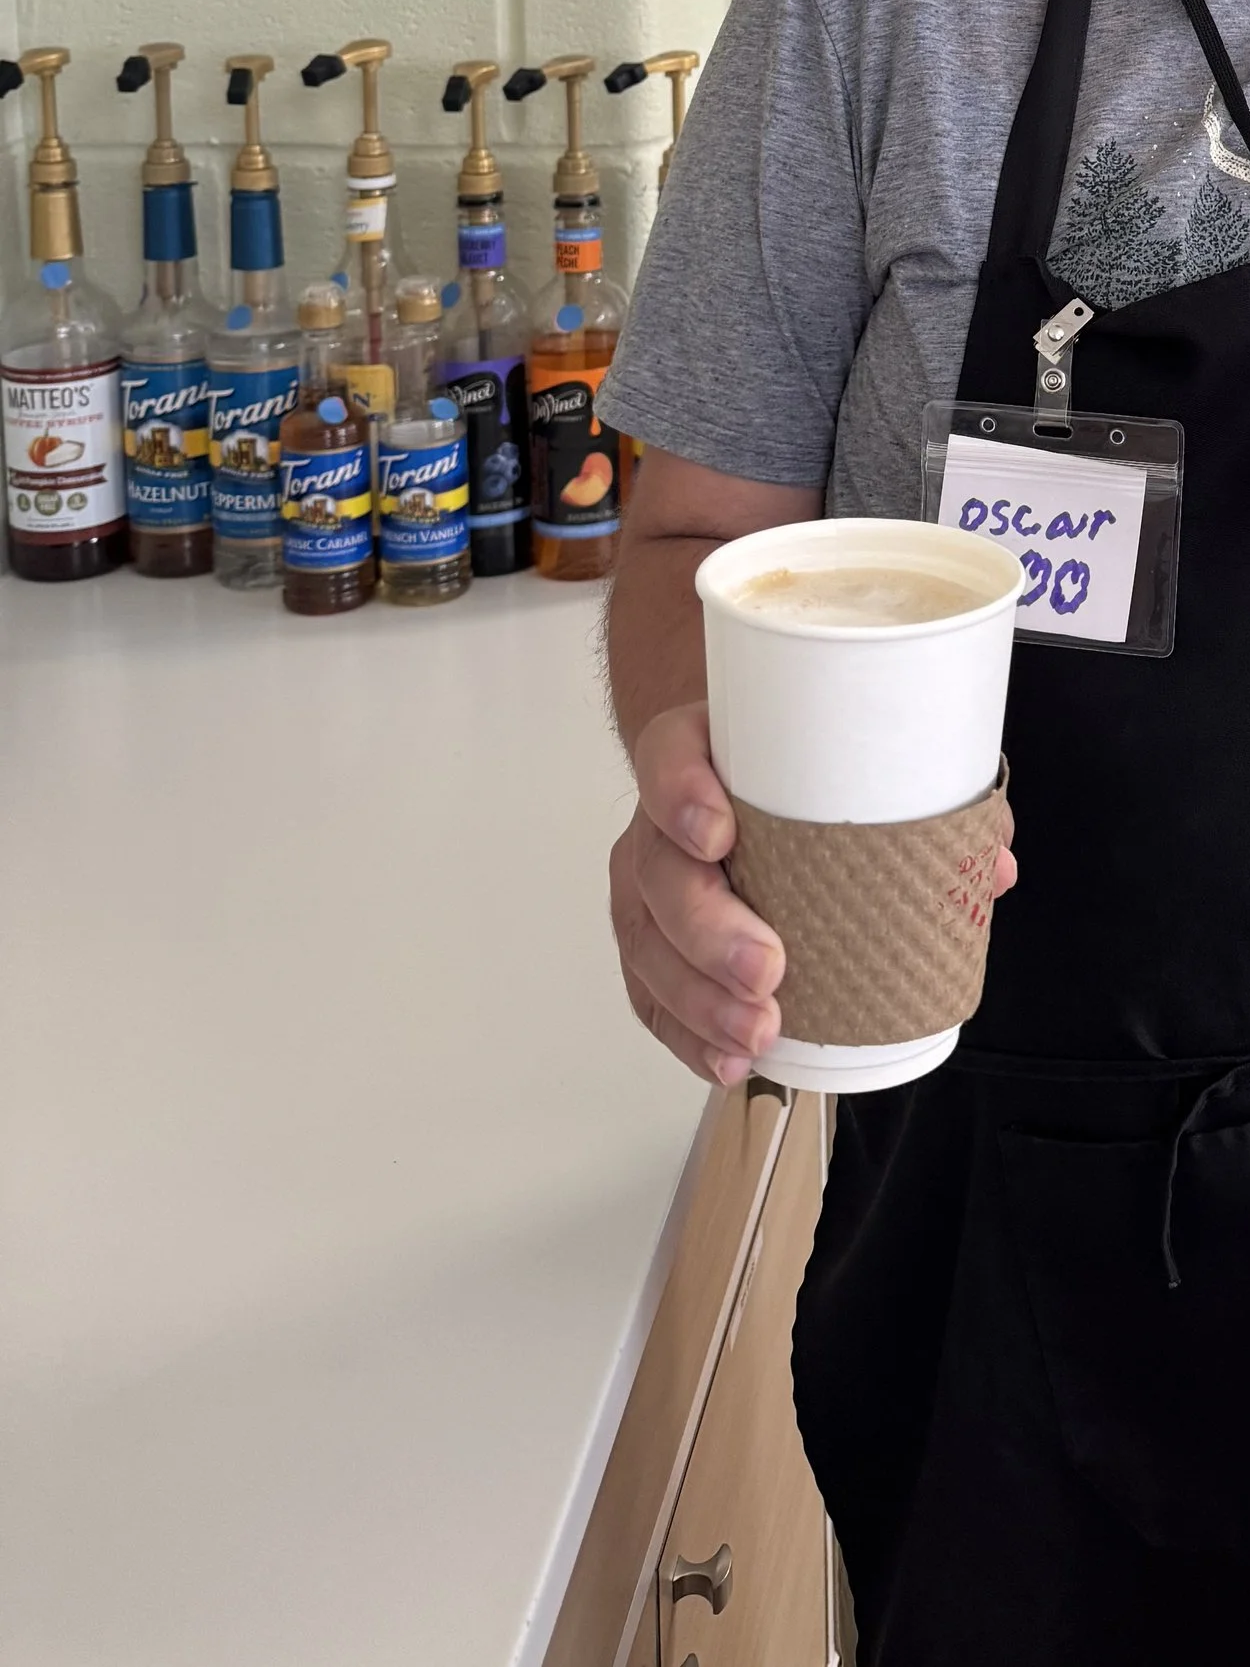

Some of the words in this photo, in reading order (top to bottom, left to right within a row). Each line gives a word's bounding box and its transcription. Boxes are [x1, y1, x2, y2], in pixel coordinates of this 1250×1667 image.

[8, 385, 91, 410] MATTEO'S
[121, 377, 209, 430] Torani
[206, 380, 298, 439] Torani
[448, 380, 496, 407] Vinci
[128, 478, 211, 503] HAZELNUT
[280, 449, 364, 503] Torani
[378, 443, 460, 499] Torani
